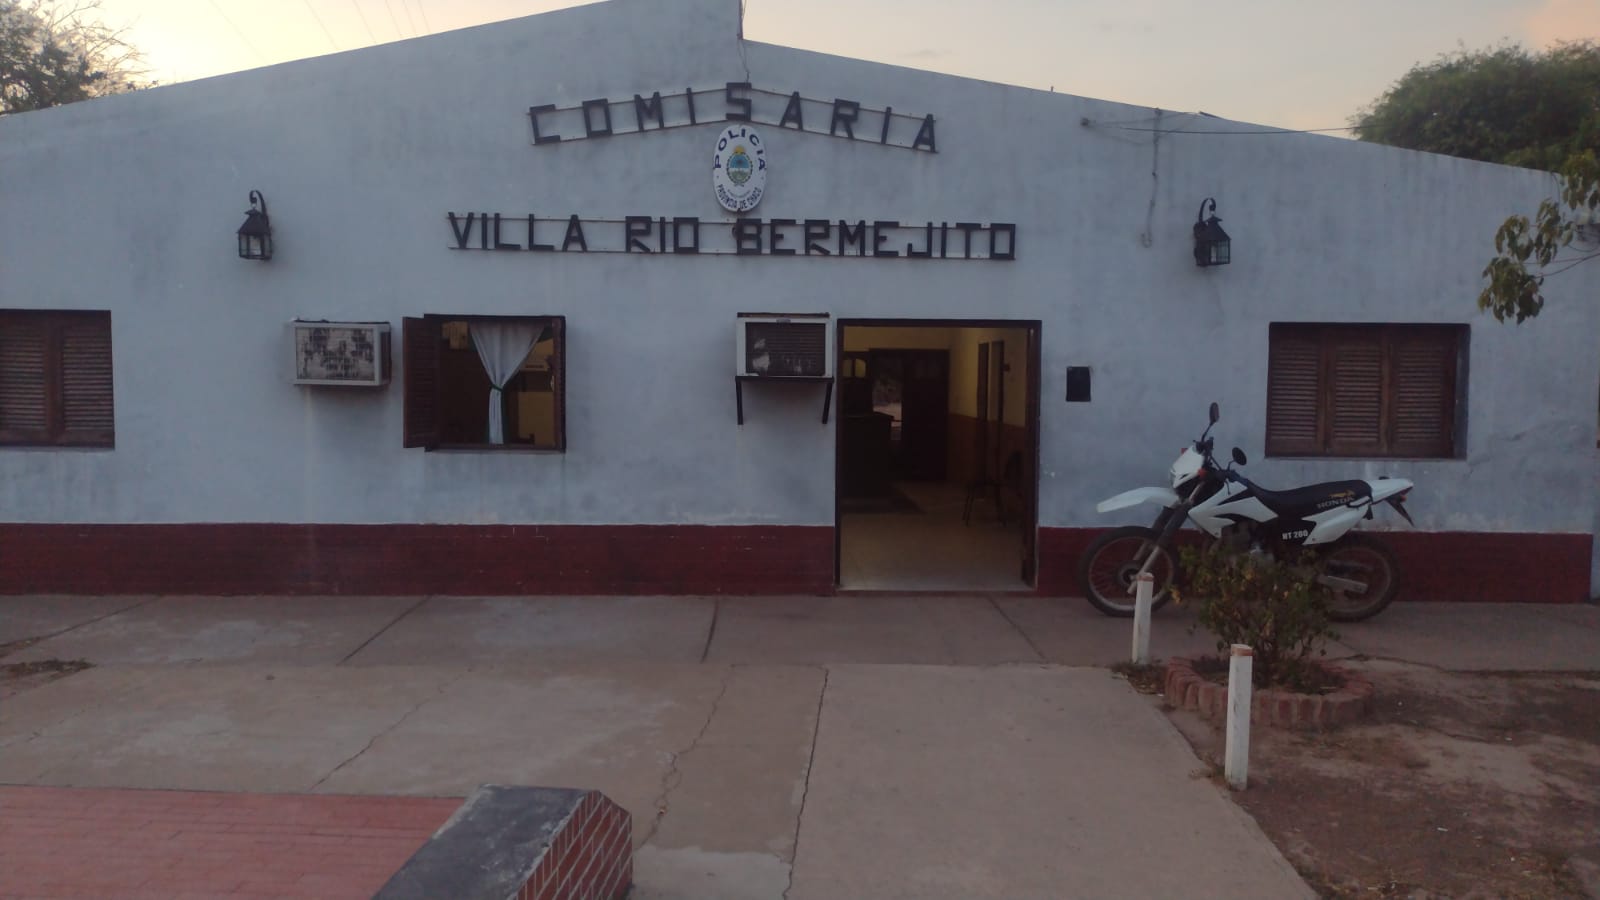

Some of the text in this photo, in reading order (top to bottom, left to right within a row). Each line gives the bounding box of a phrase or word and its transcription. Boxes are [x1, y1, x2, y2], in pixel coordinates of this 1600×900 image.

[528, 82, 937, 154] COMISARIA
[714, 128, 766, 170] POLICIA
[739, 200, 748, 209] DE
[447, 211, 1017, 260] VILLA RIO BERMEJITO
[1316, 496, 1355, 510] HONDA
